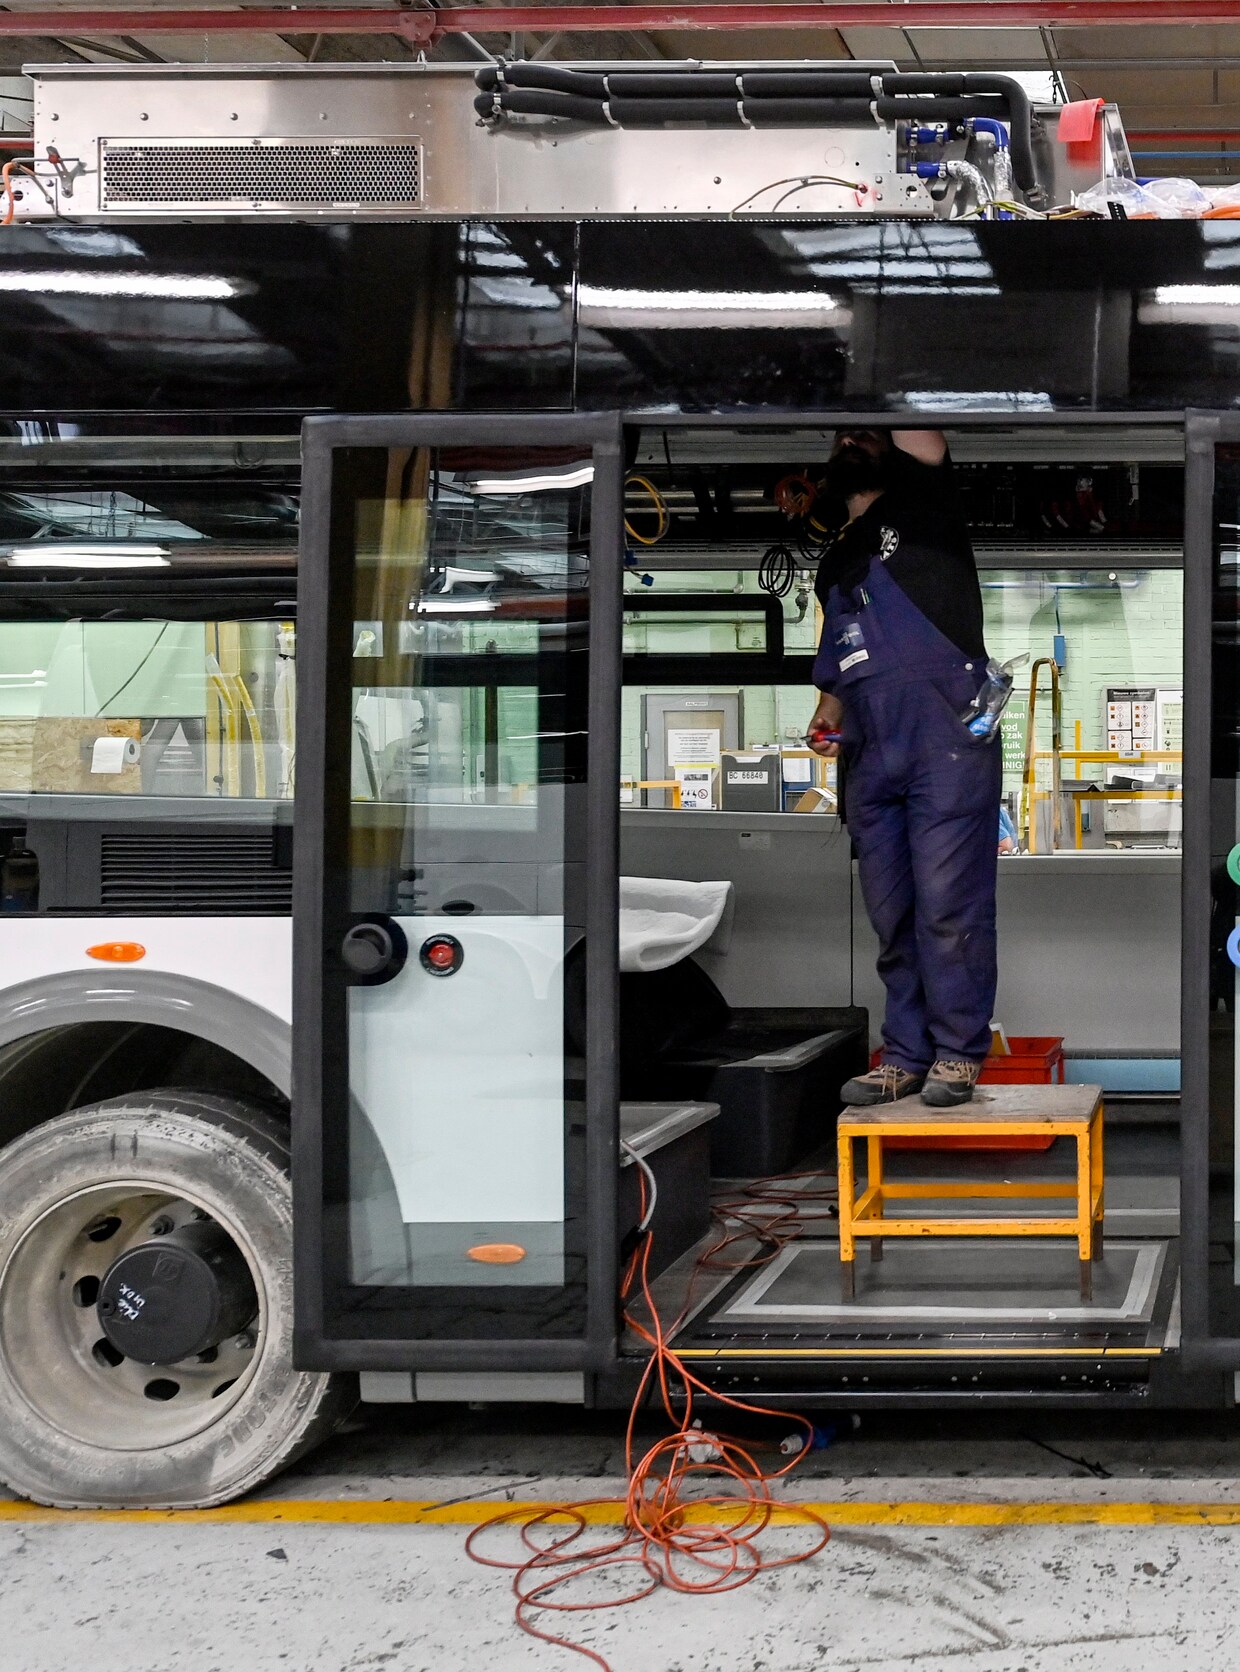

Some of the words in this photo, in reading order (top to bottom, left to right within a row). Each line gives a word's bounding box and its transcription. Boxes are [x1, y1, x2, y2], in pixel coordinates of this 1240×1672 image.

[1007, 731, 1023, 739] zak
[1002, 741, 1021, 749] ruik
[728, 771, 739, 780] BC
